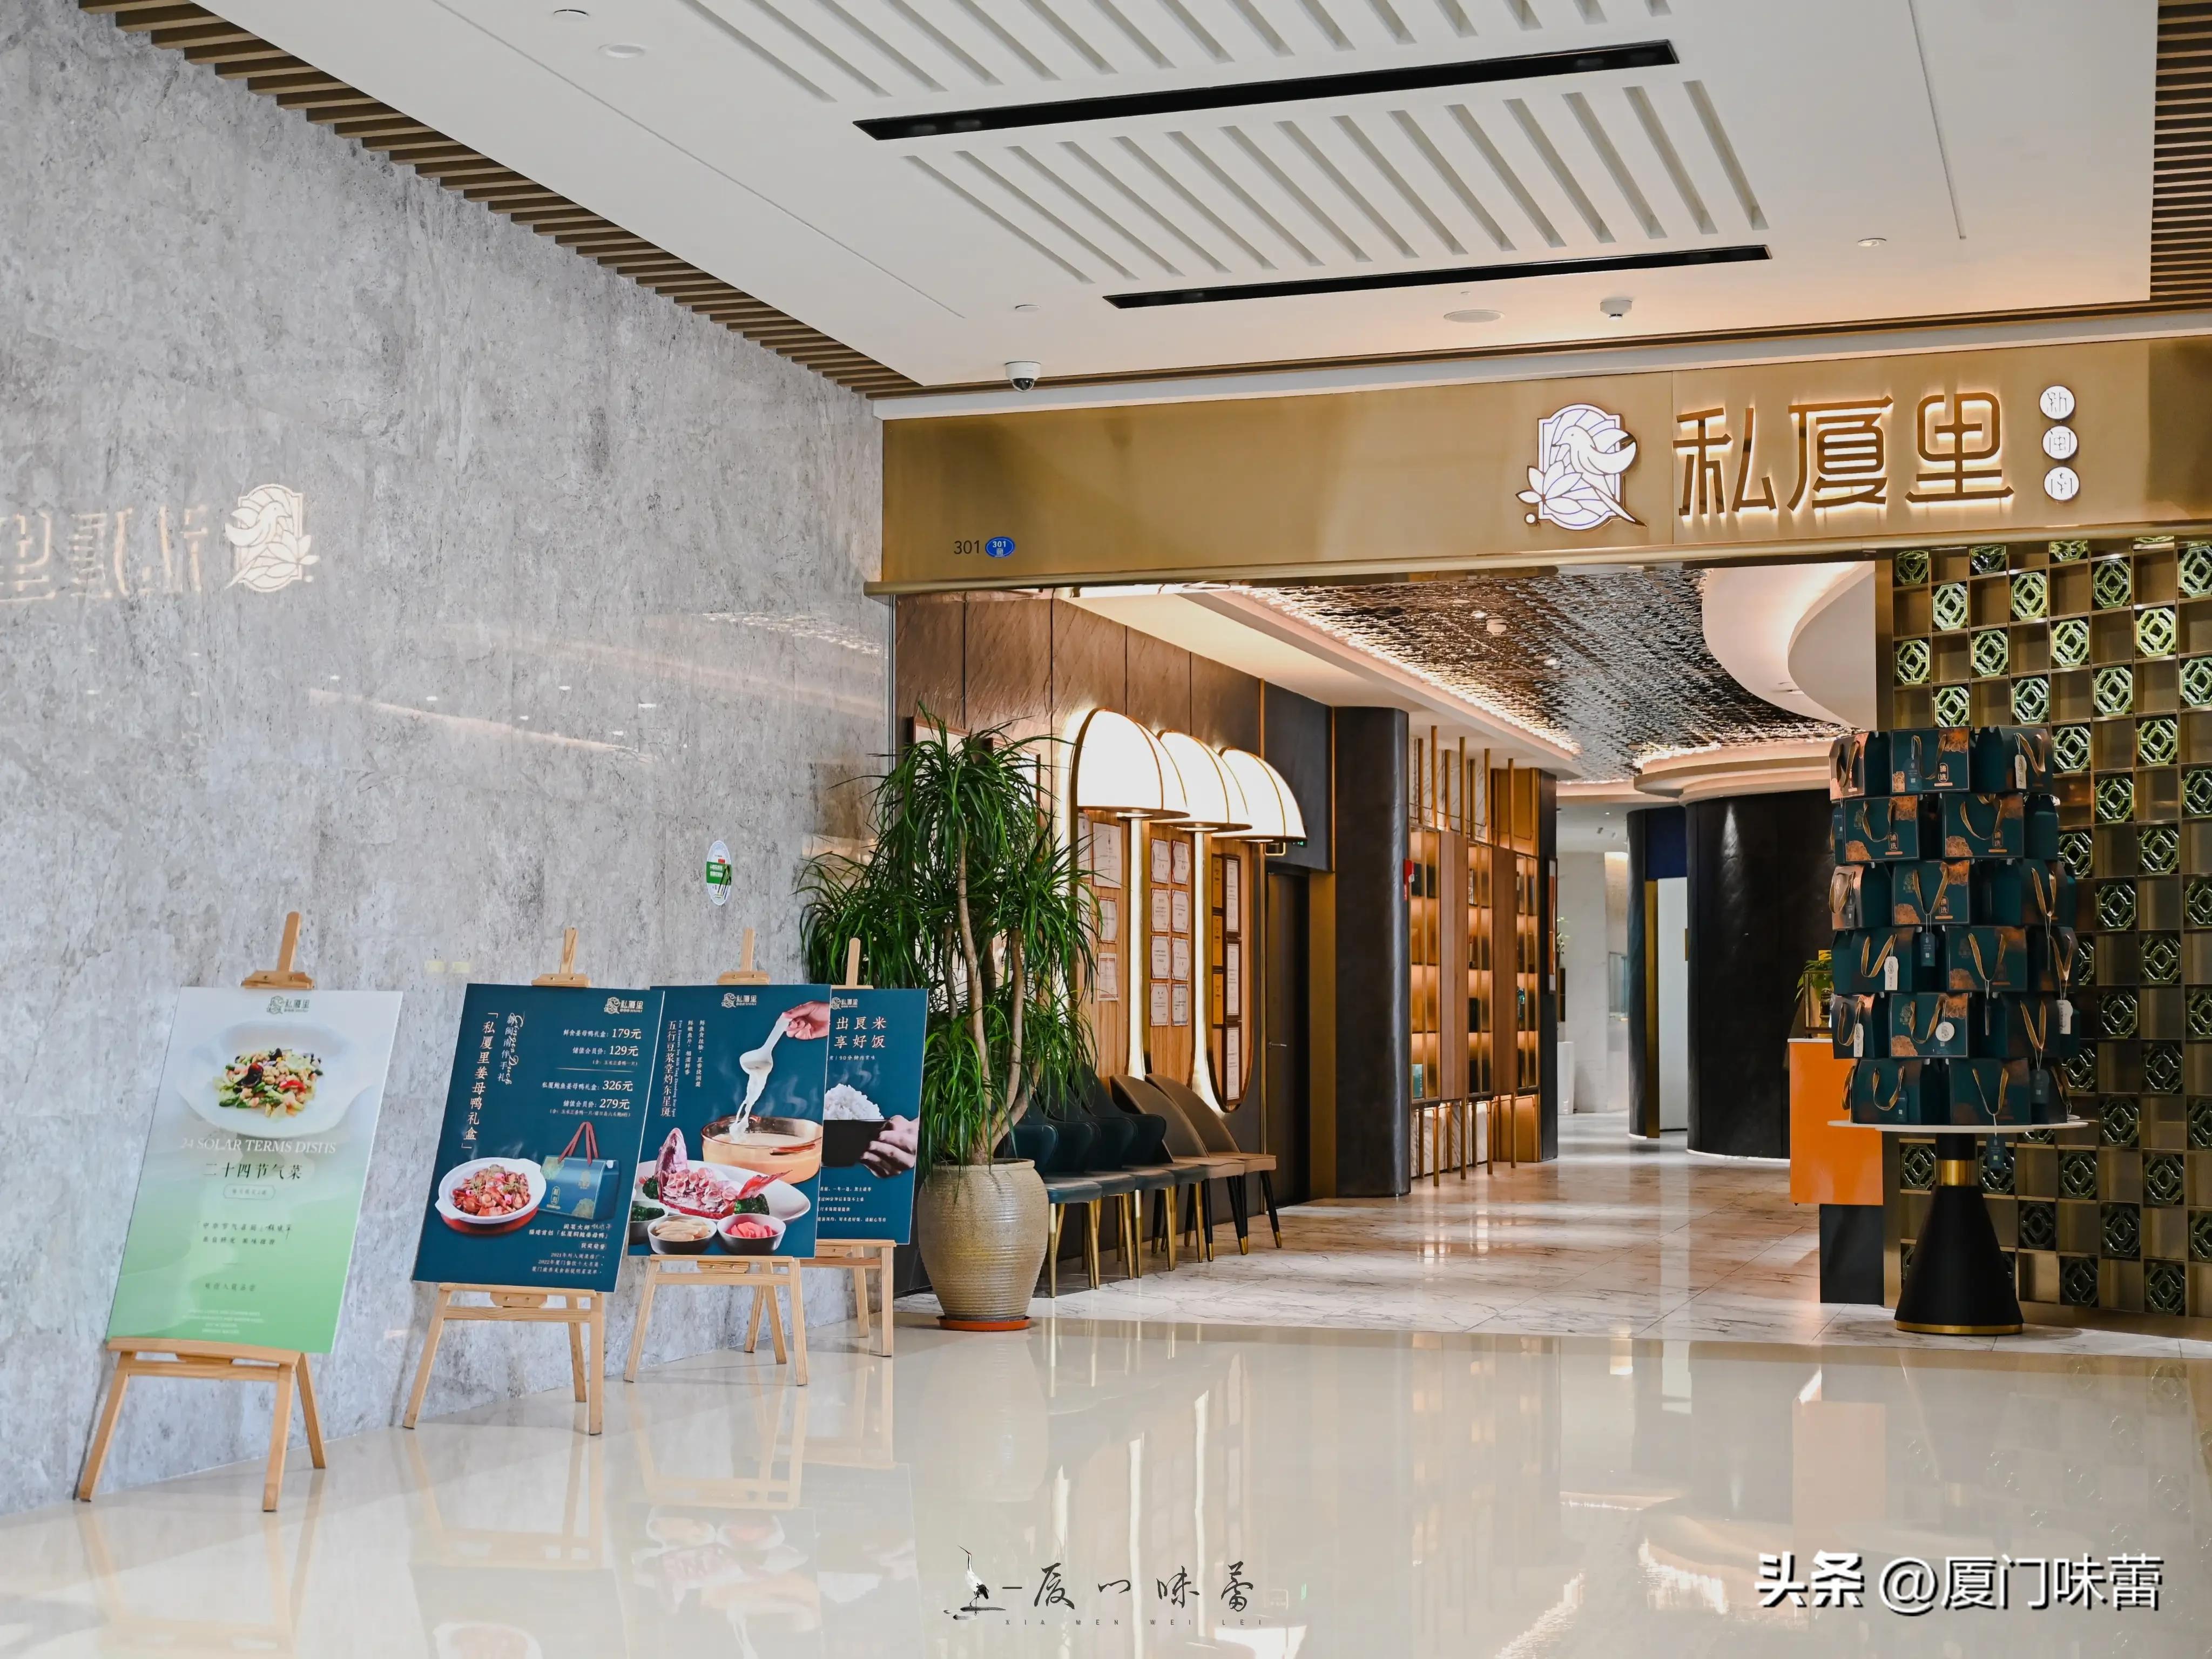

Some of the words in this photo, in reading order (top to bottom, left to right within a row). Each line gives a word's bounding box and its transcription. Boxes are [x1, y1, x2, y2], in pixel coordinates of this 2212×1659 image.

[1673, 392, 2014, 516] 私厦里
[954, 540, 979, 554] 301
[612, 1028, 642, 1040] 179元
[834, 1035, 886, 1049] 享好饭
[609, 1046, 639, 1056] 129元
[660, 1020, 677, 1117] 五行豆浆堂灼东星斑
[603, 1080, 633, 1091] 326元
[599, 1098, 630, 1110] 279元
[197, 1139, 242, 1151] SOLAR
[245, 1139, 293, 1153] TERMS
[203, 1162, 302, 1180] 二十四节气菜
